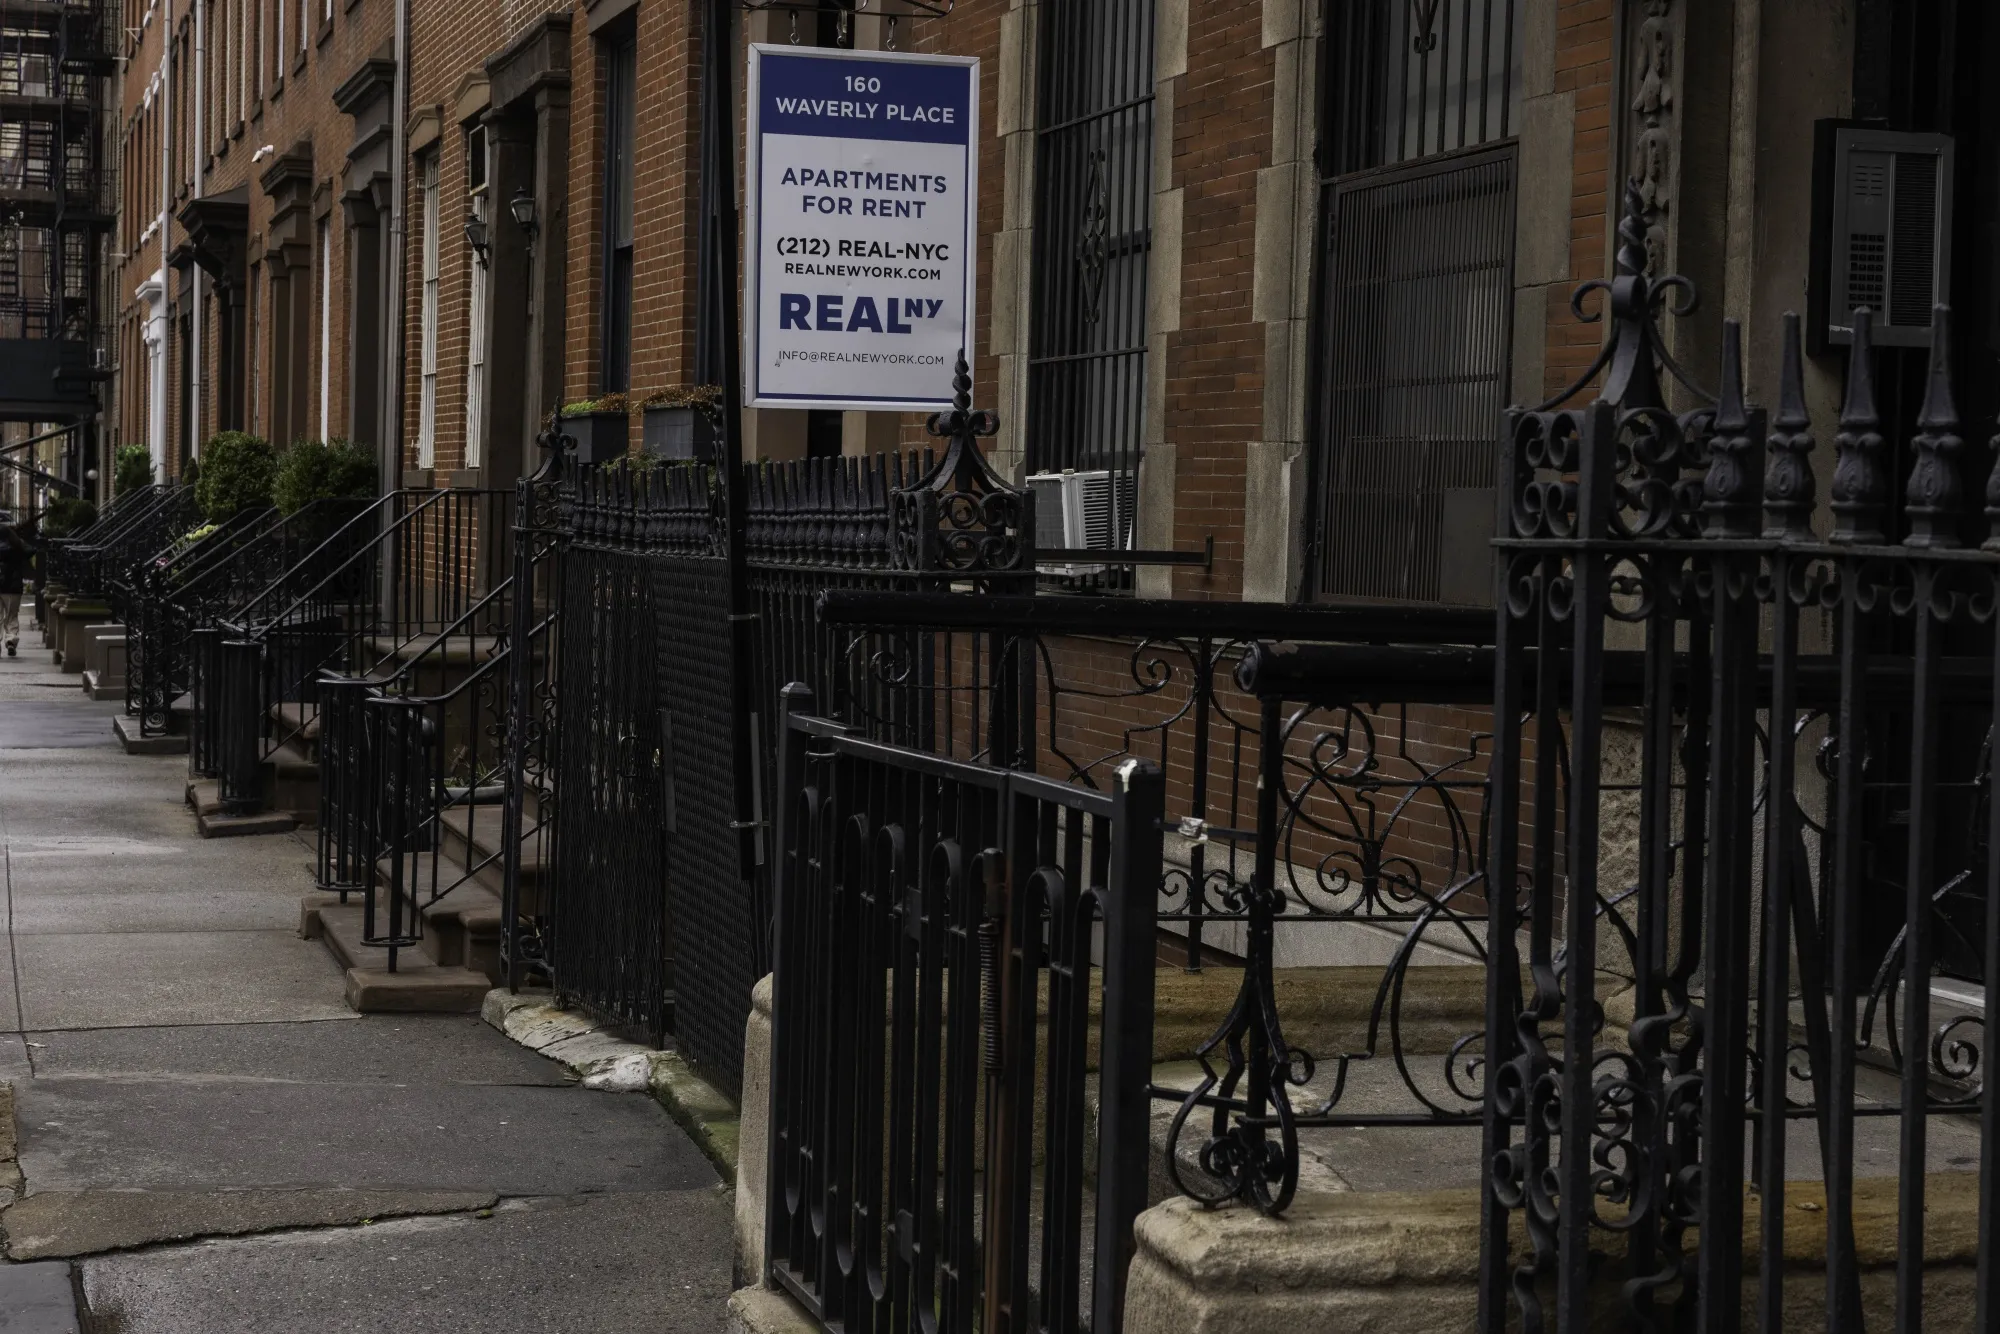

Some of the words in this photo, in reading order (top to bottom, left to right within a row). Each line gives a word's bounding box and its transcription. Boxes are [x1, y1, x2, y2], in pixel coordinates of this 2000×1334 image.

[845, 76, 881, 93] 160
[775, 98, 879, 120] WAVERLY
[886, 105, 955, 123] PLACE
[781, 168, 947, 193] APARTMENTS
[803, 196, 854, 215] FOR
[862, 199, 926, 218] RENT
[777, 237, 830, 258] (212)
[839, 240, 949, 260] REAL-NYC
[785, 263, 941, 280] REALNEWYORK.COM
[779, 351, 944, 365] INFO@REALNEWYORK.COM
